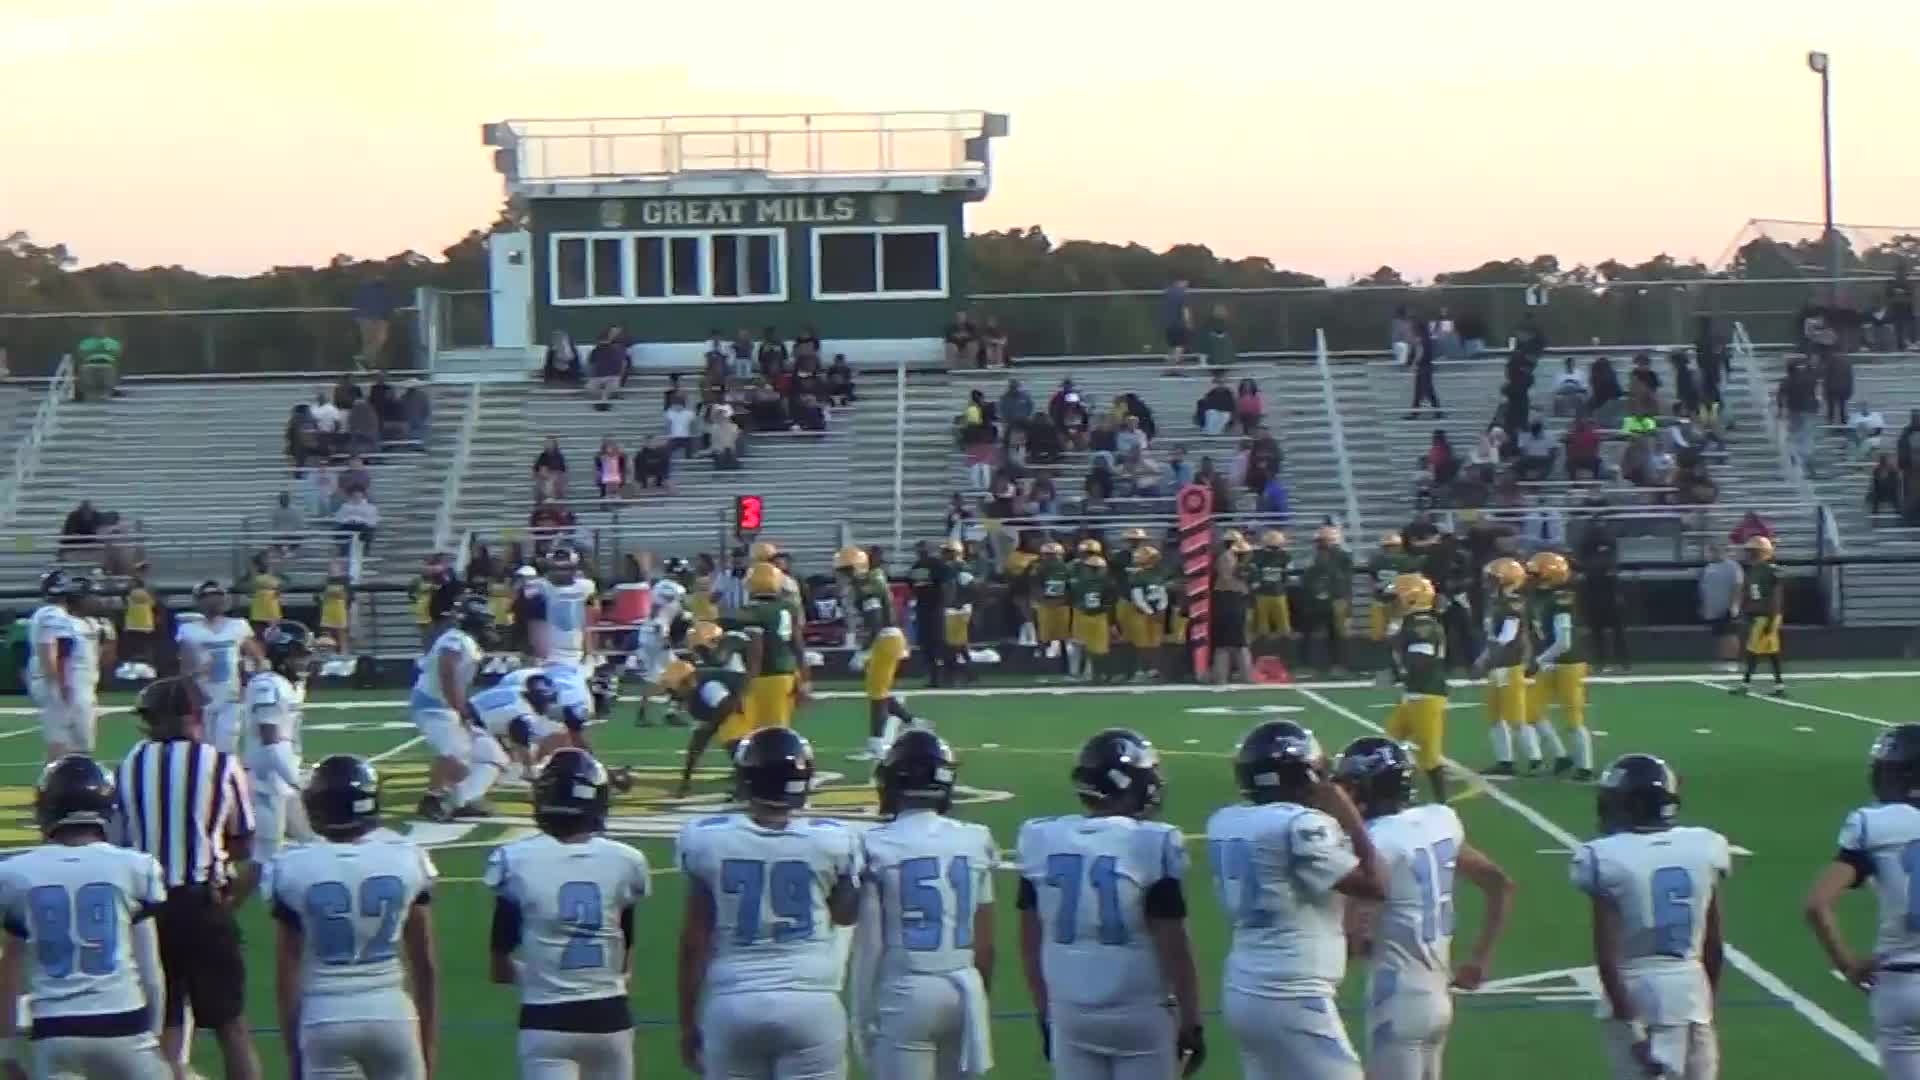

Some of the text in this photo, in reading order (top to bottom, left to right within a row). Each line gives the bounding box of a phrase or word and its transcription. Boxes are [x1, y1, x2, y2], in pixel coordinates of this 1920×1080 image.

[642, 197, 856, 225] GREAT MILLS
[740, 497, 762, 529] 3
[558, 881, 603, 969] 2
[721, 858, 815, 946] 79
[900, 856, 972, 950] 51
[1047, 853, 1127, 945] 71
